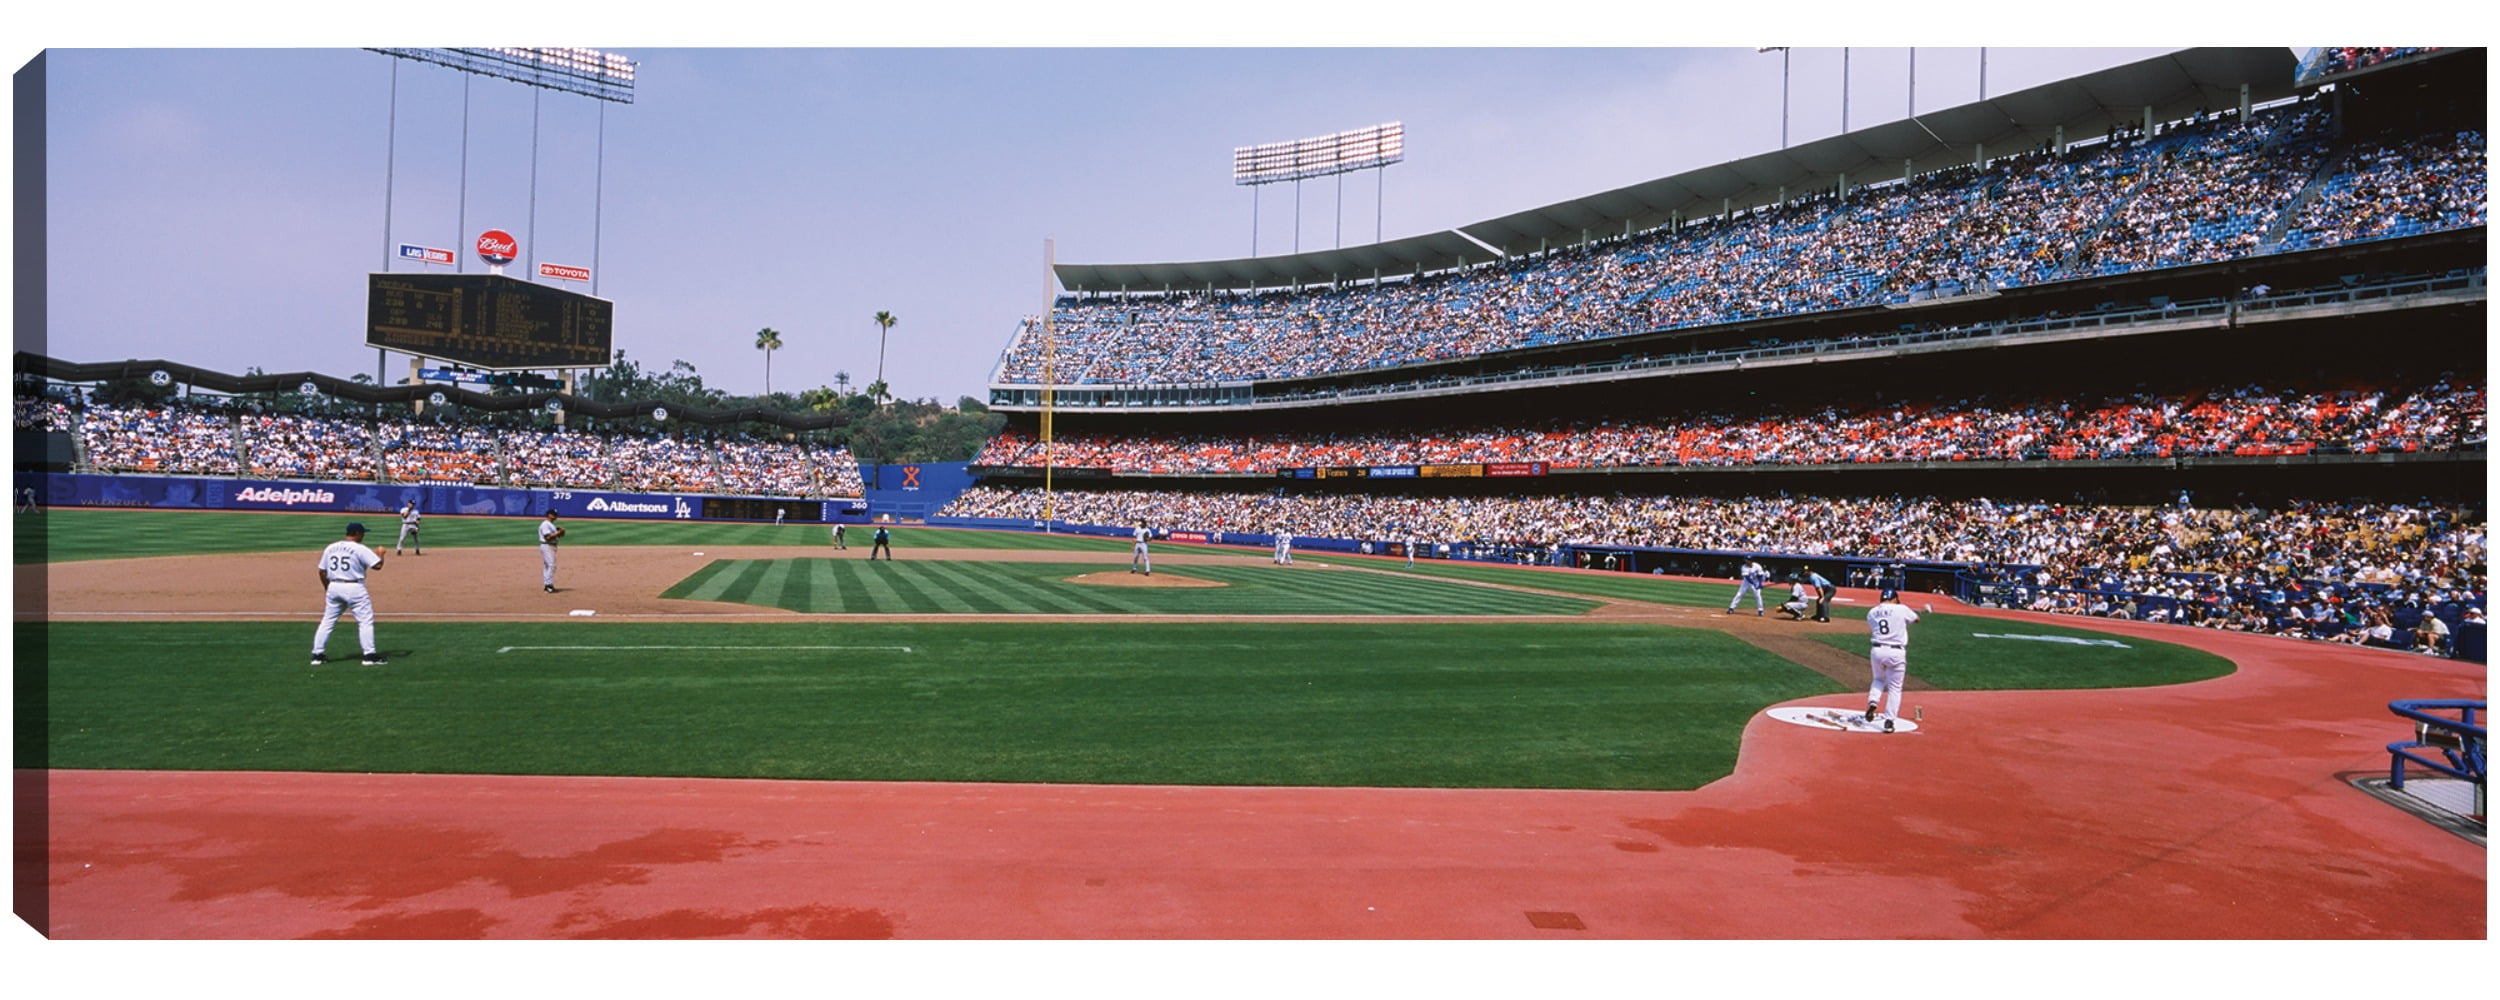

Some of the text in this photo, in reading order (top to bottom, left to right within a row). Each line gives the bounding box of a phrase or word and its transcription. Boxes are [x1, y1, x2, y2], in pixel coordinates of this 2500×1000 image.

[480, 238, 514, 251] Bud
[555, 268, 589, 278] TOYOTA
[154, 373, 167, 381] 24
[235, 487, 335, 505] Adelphia
[553, 492, 572, 500] 375
[610, 501, 668, 513] Albertsons
[674, 497, 691, 518] LA
[851, 502, 868, 510] 360
[330, 555, 350, 572] 35
[1879, 619, 1890, 635] 8
